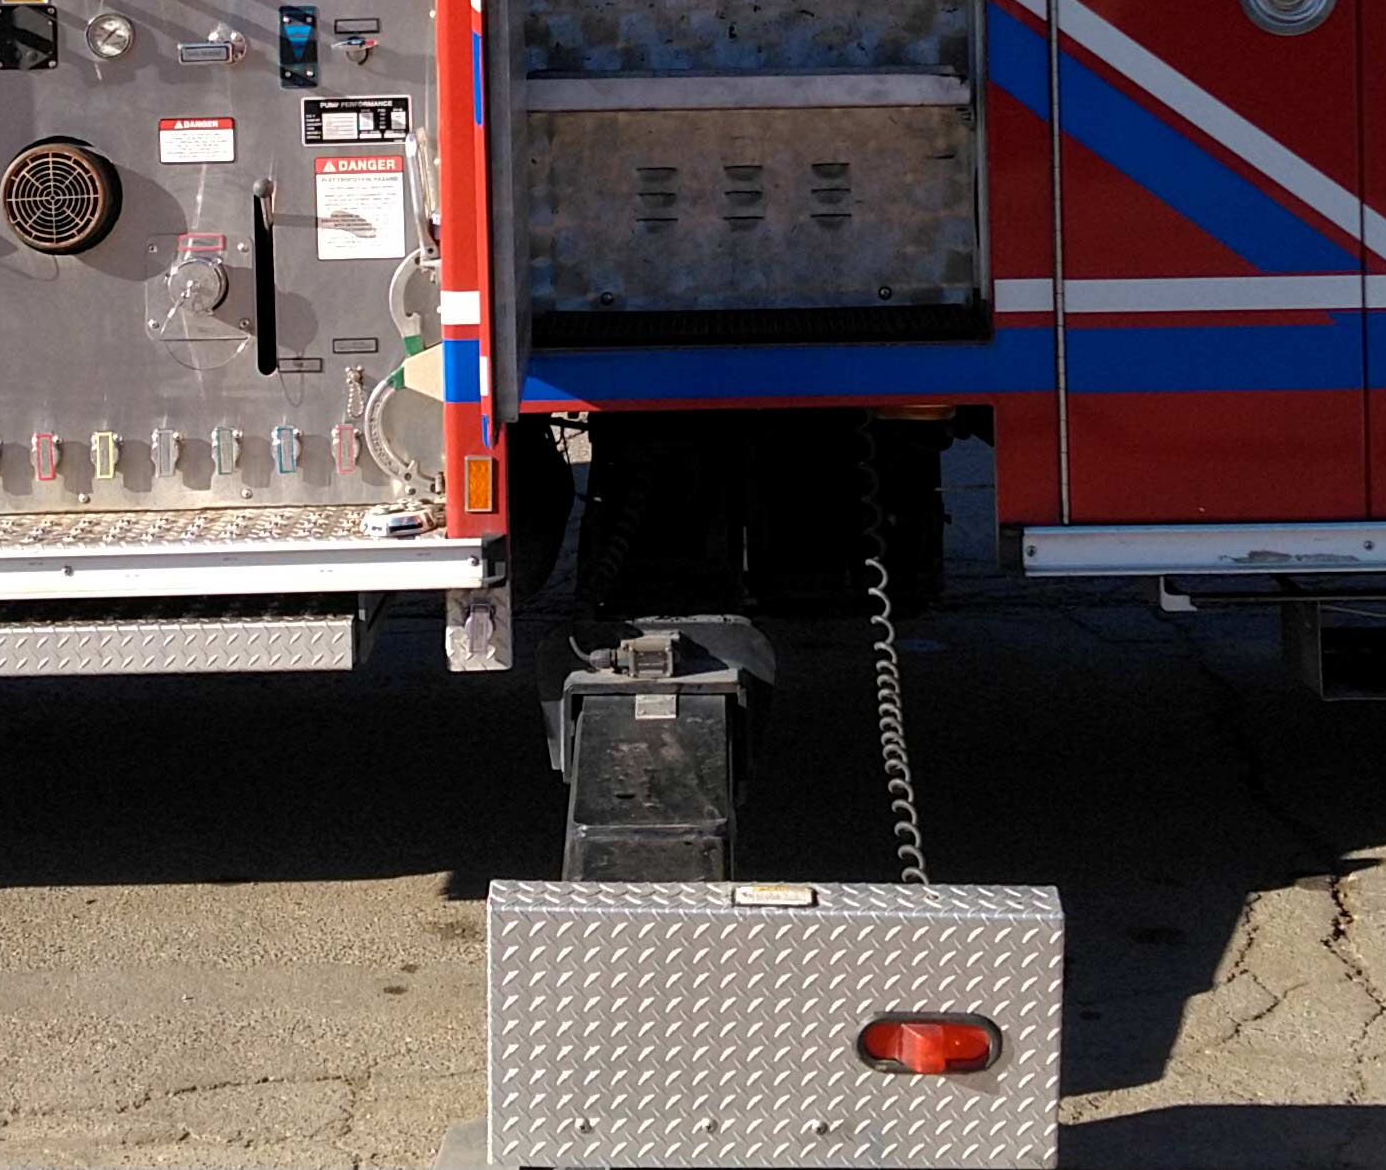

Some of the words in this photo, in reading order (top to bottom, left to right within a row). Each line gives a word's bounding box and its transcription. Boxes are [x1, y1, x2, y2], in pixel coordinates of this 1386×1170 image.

[340, 100, 393, 108] PERFORMANCE
[183, 120, 219, 129] DANGER
[338, 159, 396, 171] DANGER
